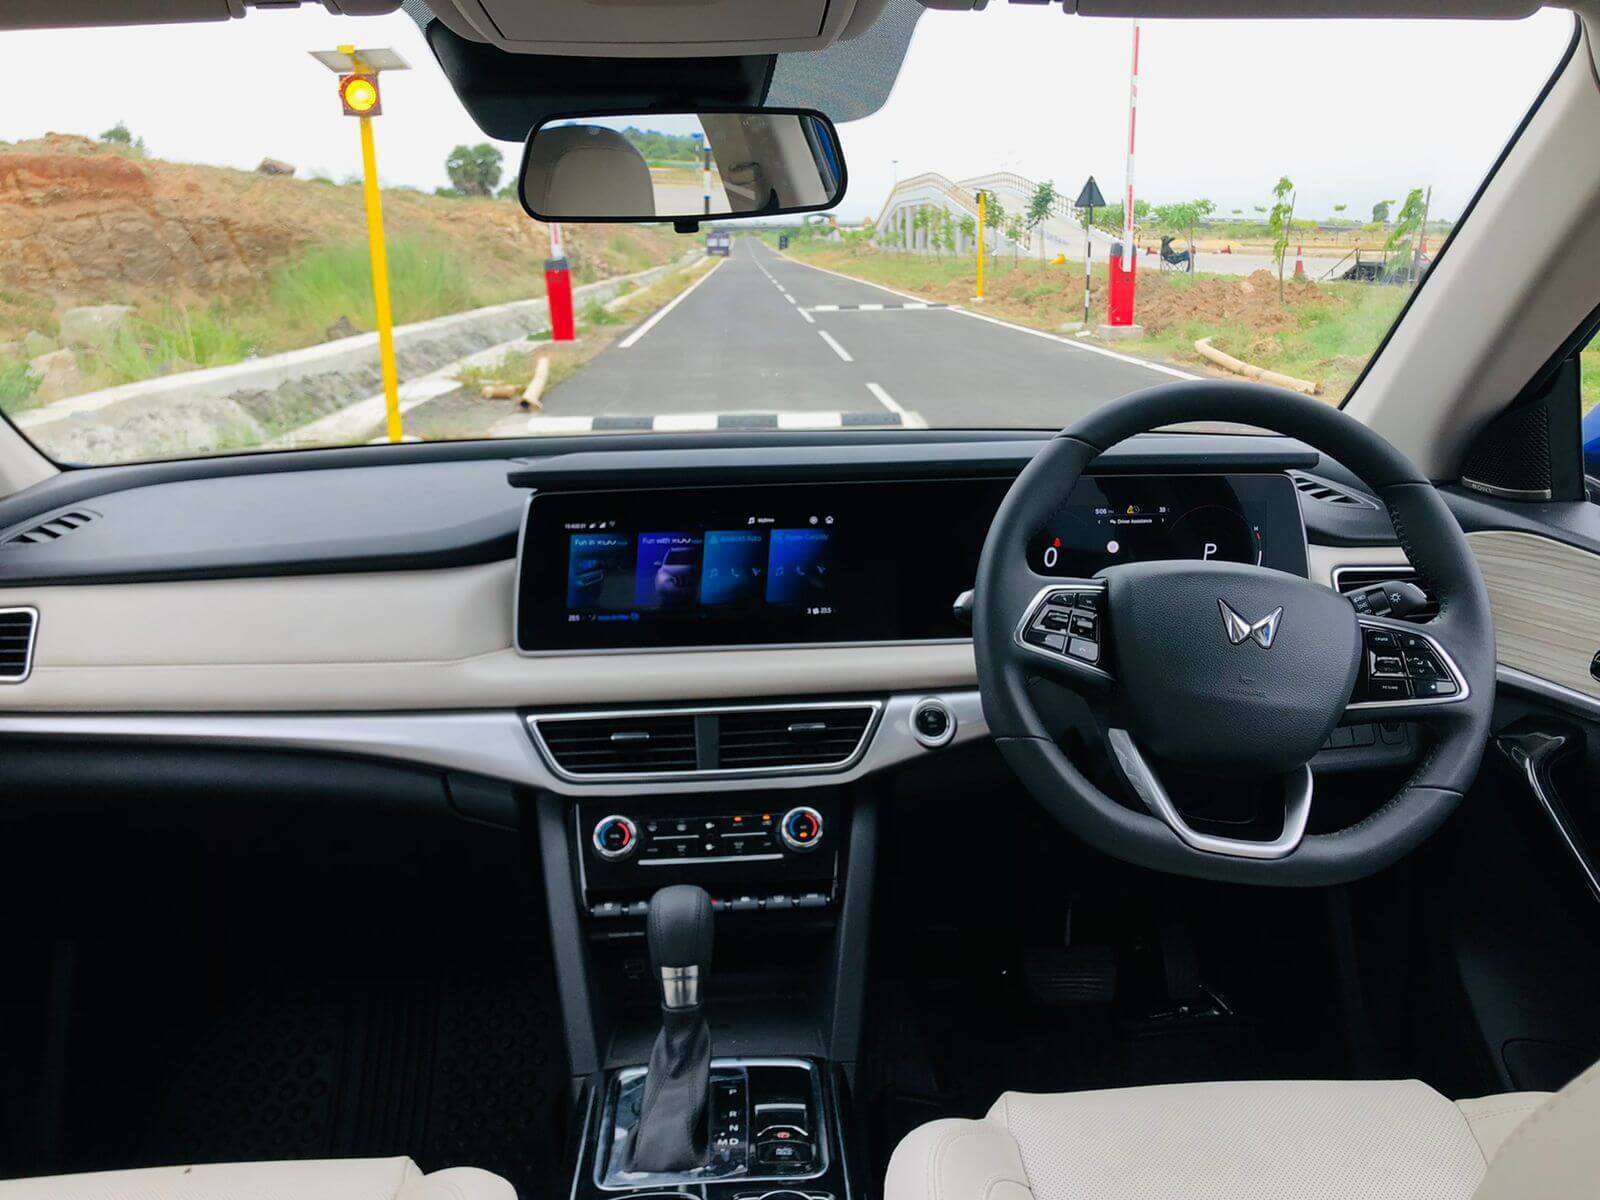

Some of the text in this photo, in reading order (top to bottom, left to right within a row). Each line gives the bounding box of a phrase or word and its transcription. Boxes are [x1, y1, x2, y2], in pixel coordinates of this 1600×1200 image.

[1203, 543, 1217, 561] P
[1044, 547, 1058, 568] 0
[729, 1110, 737, 1118] R
[729, 1124, 739, 1132] N
[729, 1138, 740, 1146] D
